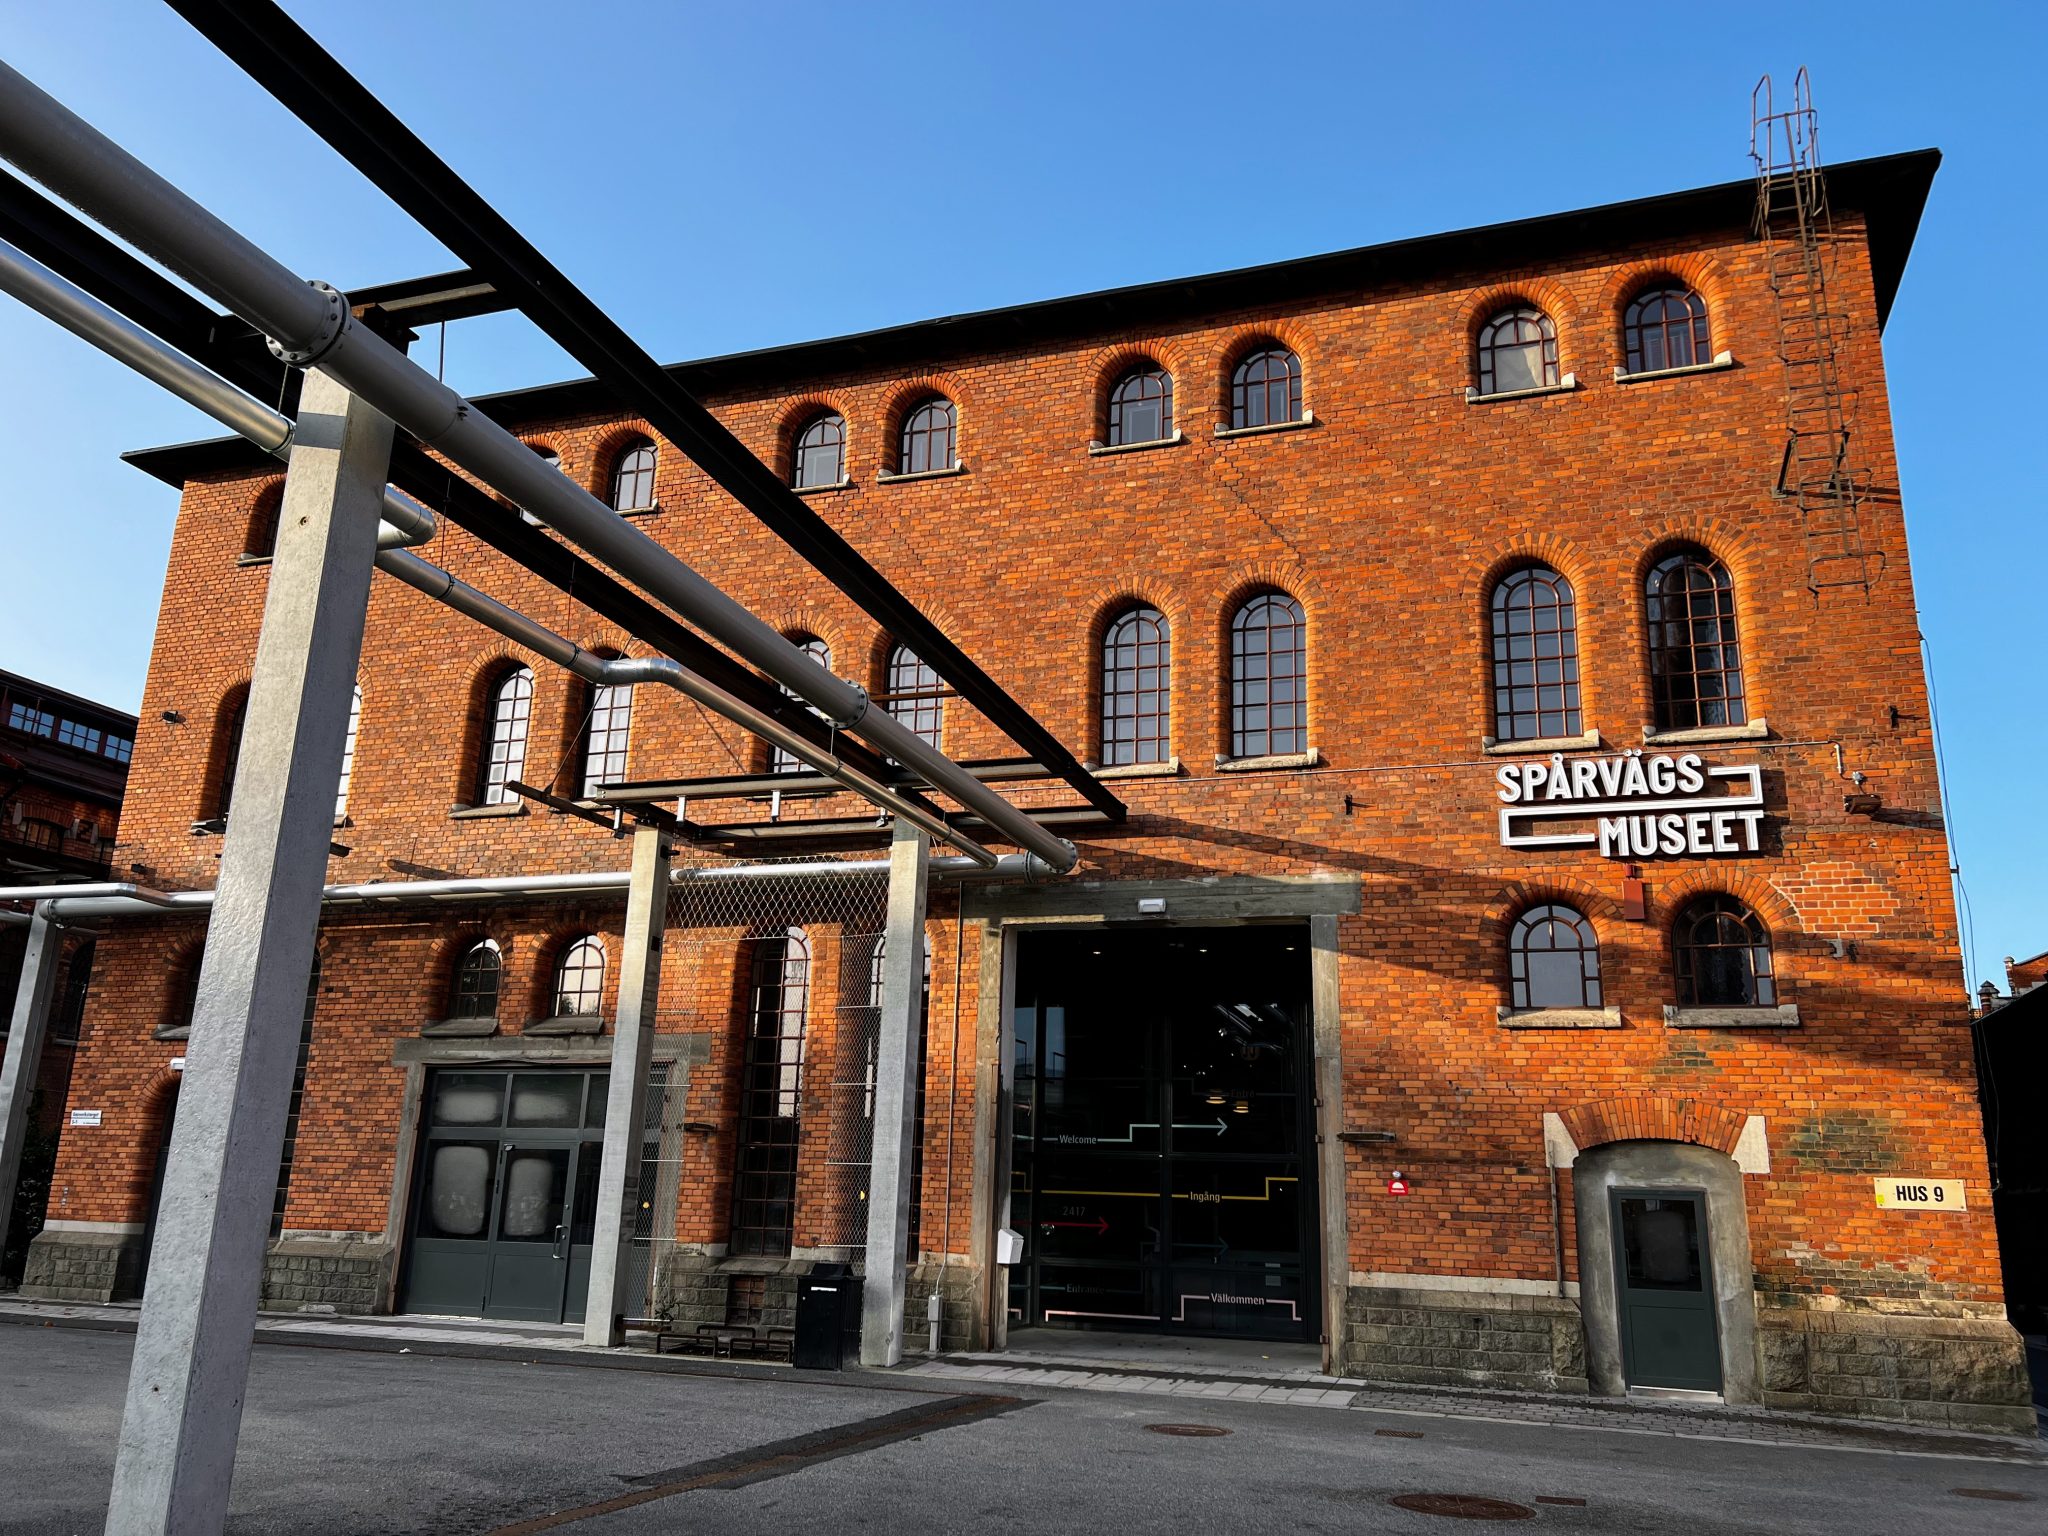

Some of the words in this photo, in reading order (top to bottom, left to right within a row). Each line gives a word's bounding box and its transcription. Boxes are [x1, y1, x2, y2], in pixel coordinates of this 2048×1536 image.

[1496, 749, 1704, 802] SPÅRVÄGS
[1599, 809, 1764, 857] MUSEET
[1059, 1134, 1097, 1144] Welcome
[1190, 1190, 1220, 1203] Ingång
[1896, 1185, 1928, 1202] HUS
[1933, 1186, 1944, 1202] 9
[1062, 1205, 1086, 1217] 2417
[1066, 1283, 1105, 1295] Entrance
[1210, 1292, 1265, 1305] Välkommen
